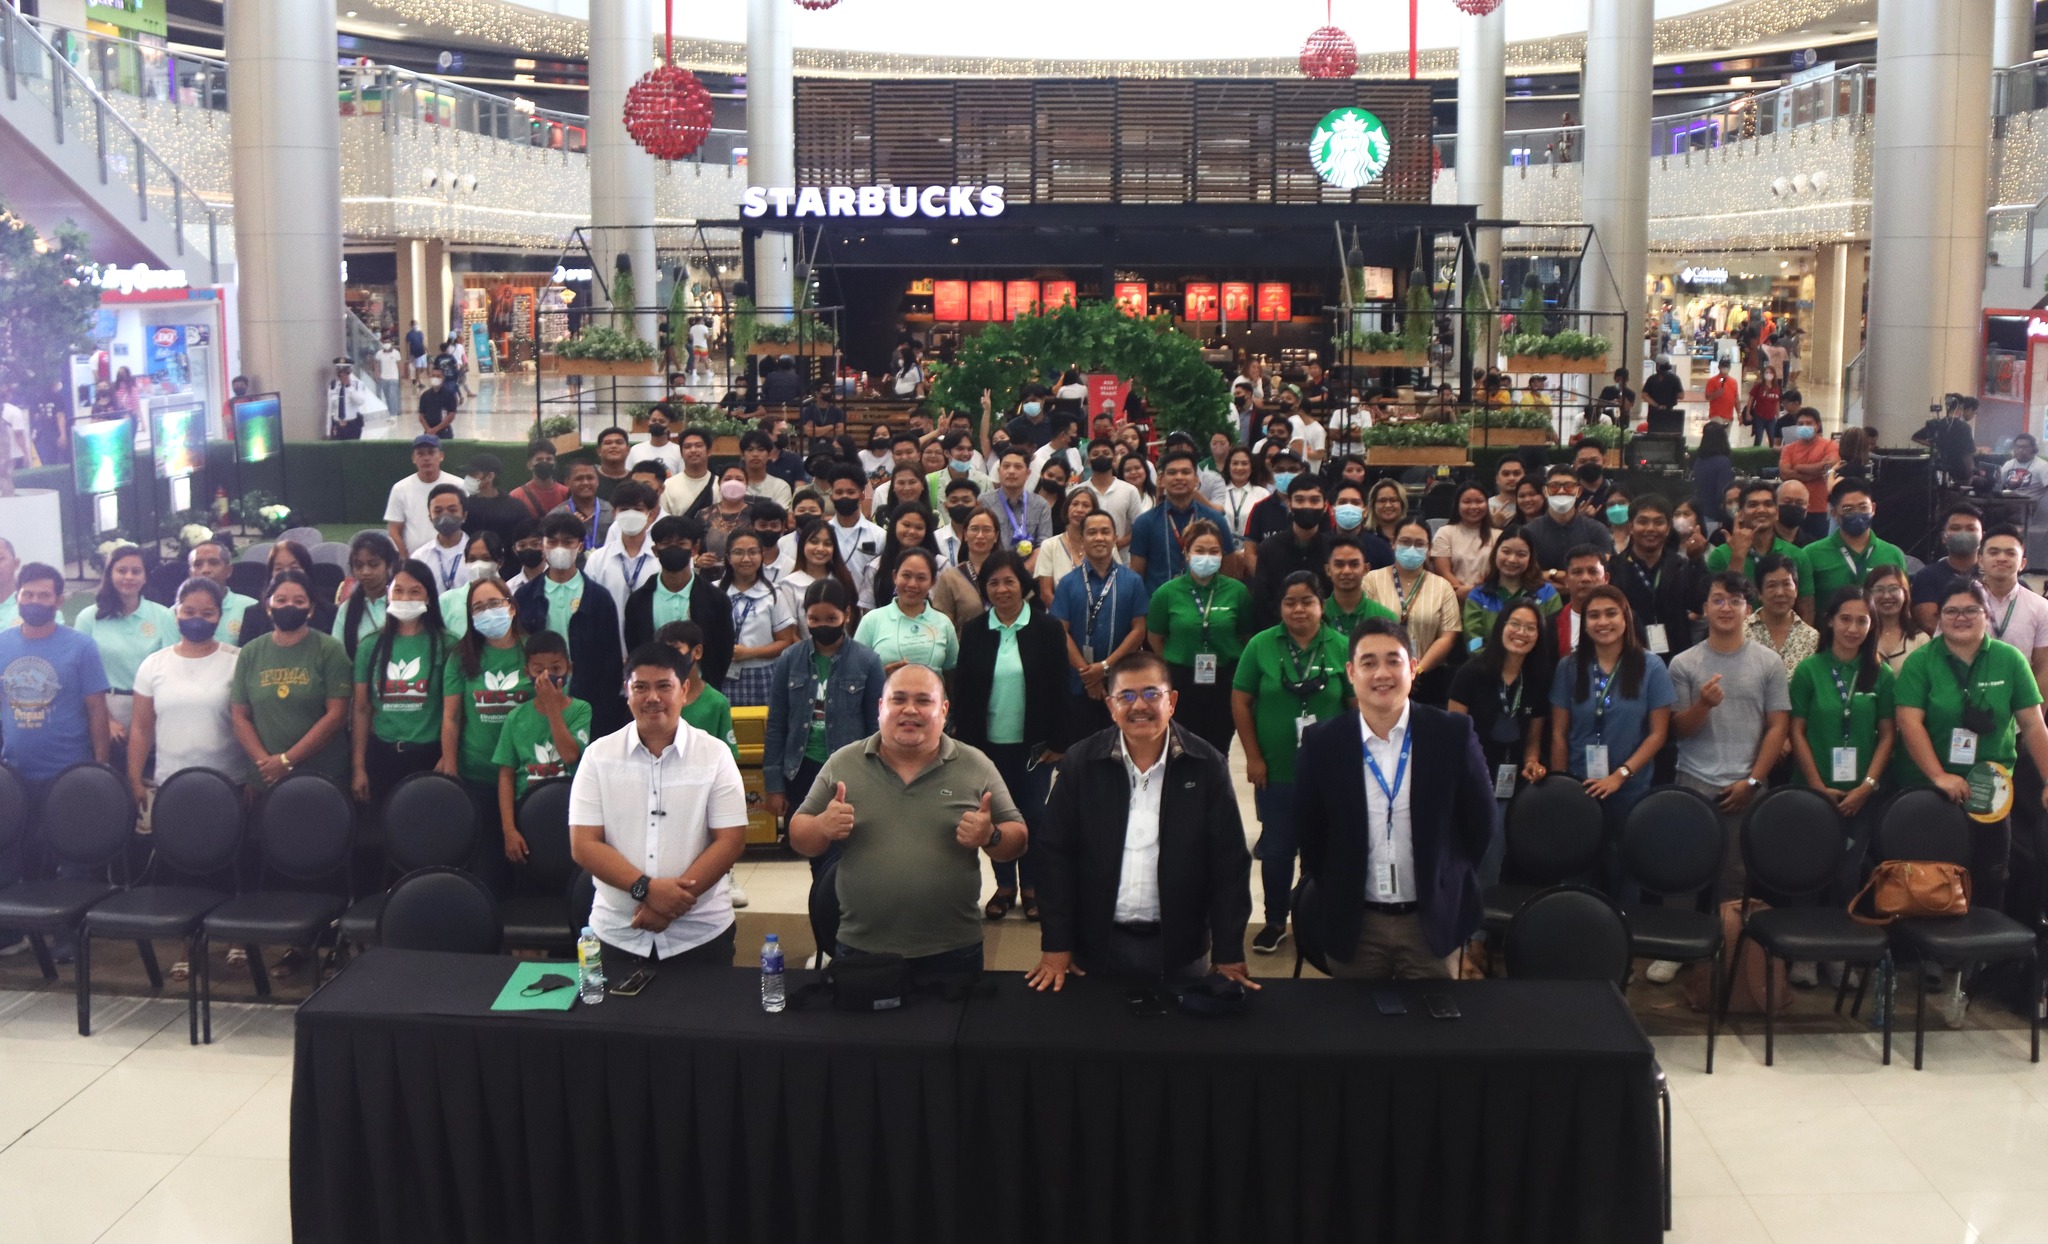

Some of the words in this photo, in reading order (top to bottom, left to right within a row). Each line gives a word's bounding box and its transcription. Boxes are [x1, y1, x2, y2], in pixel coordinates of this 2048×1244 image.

[743, 185, 1006, 218] STARBUCKS
[259, 667, 310, 686] PUMA
[377, 679, 428, 693] ES-O
[473, 689, 528, 704] YES-O
[526, 763, 565, 777] YES-
